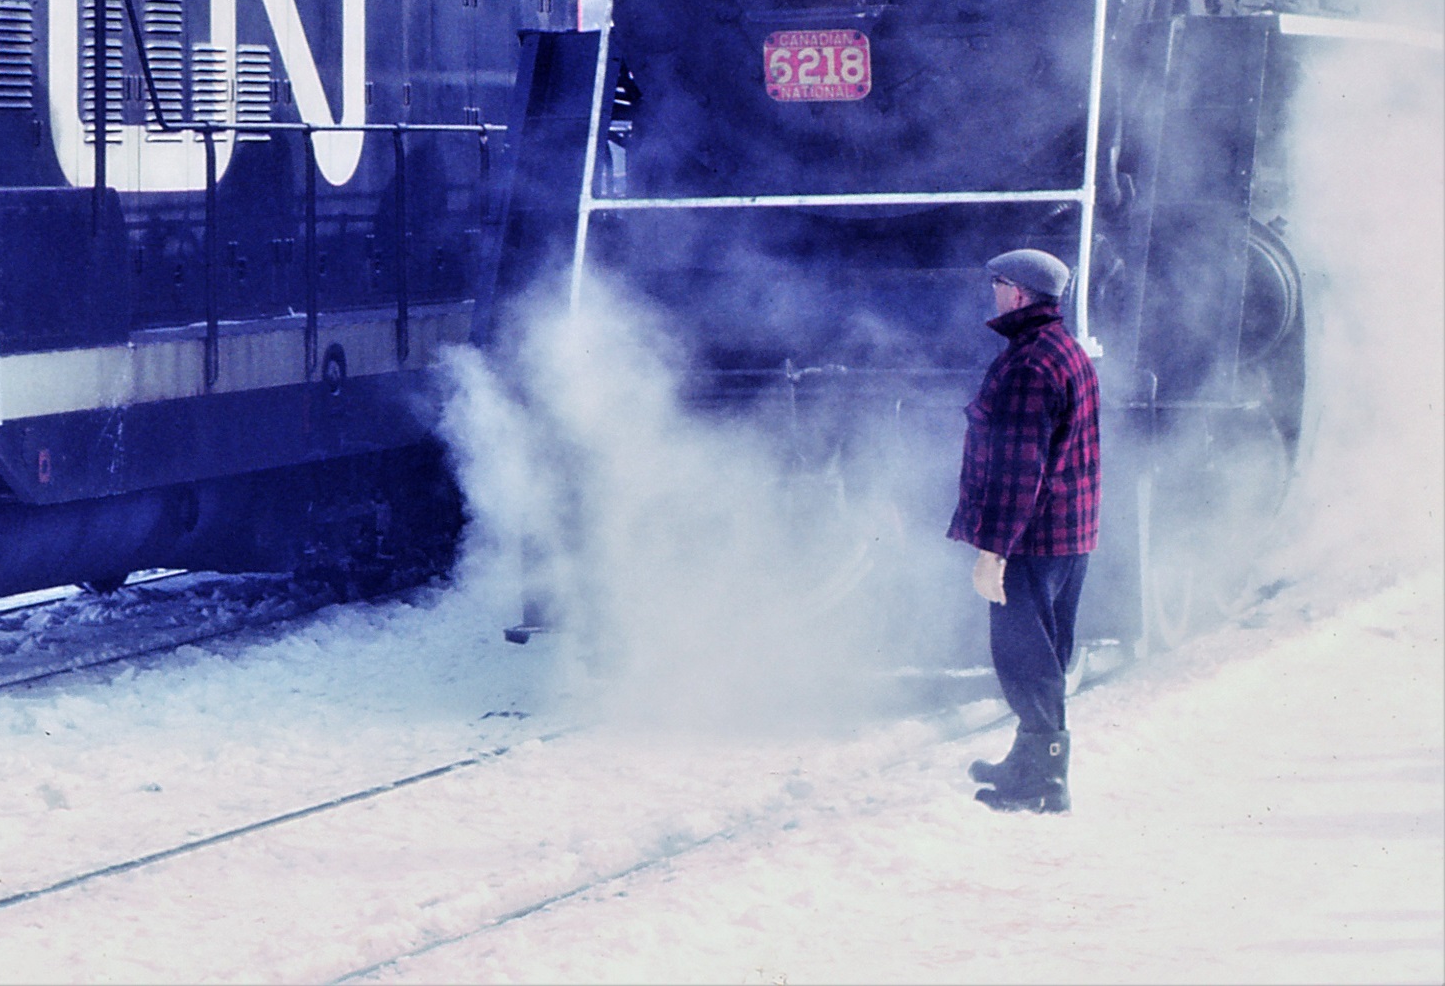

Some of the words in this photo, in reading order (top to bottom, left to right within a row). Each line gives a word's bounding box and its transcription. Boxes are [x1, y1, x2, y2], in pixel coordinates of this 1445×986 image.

[779, 33, 853, 46] CANADIAN
[769, 46, 864, 84] 6218
[781, 85, 855, 98] NATIONAL
